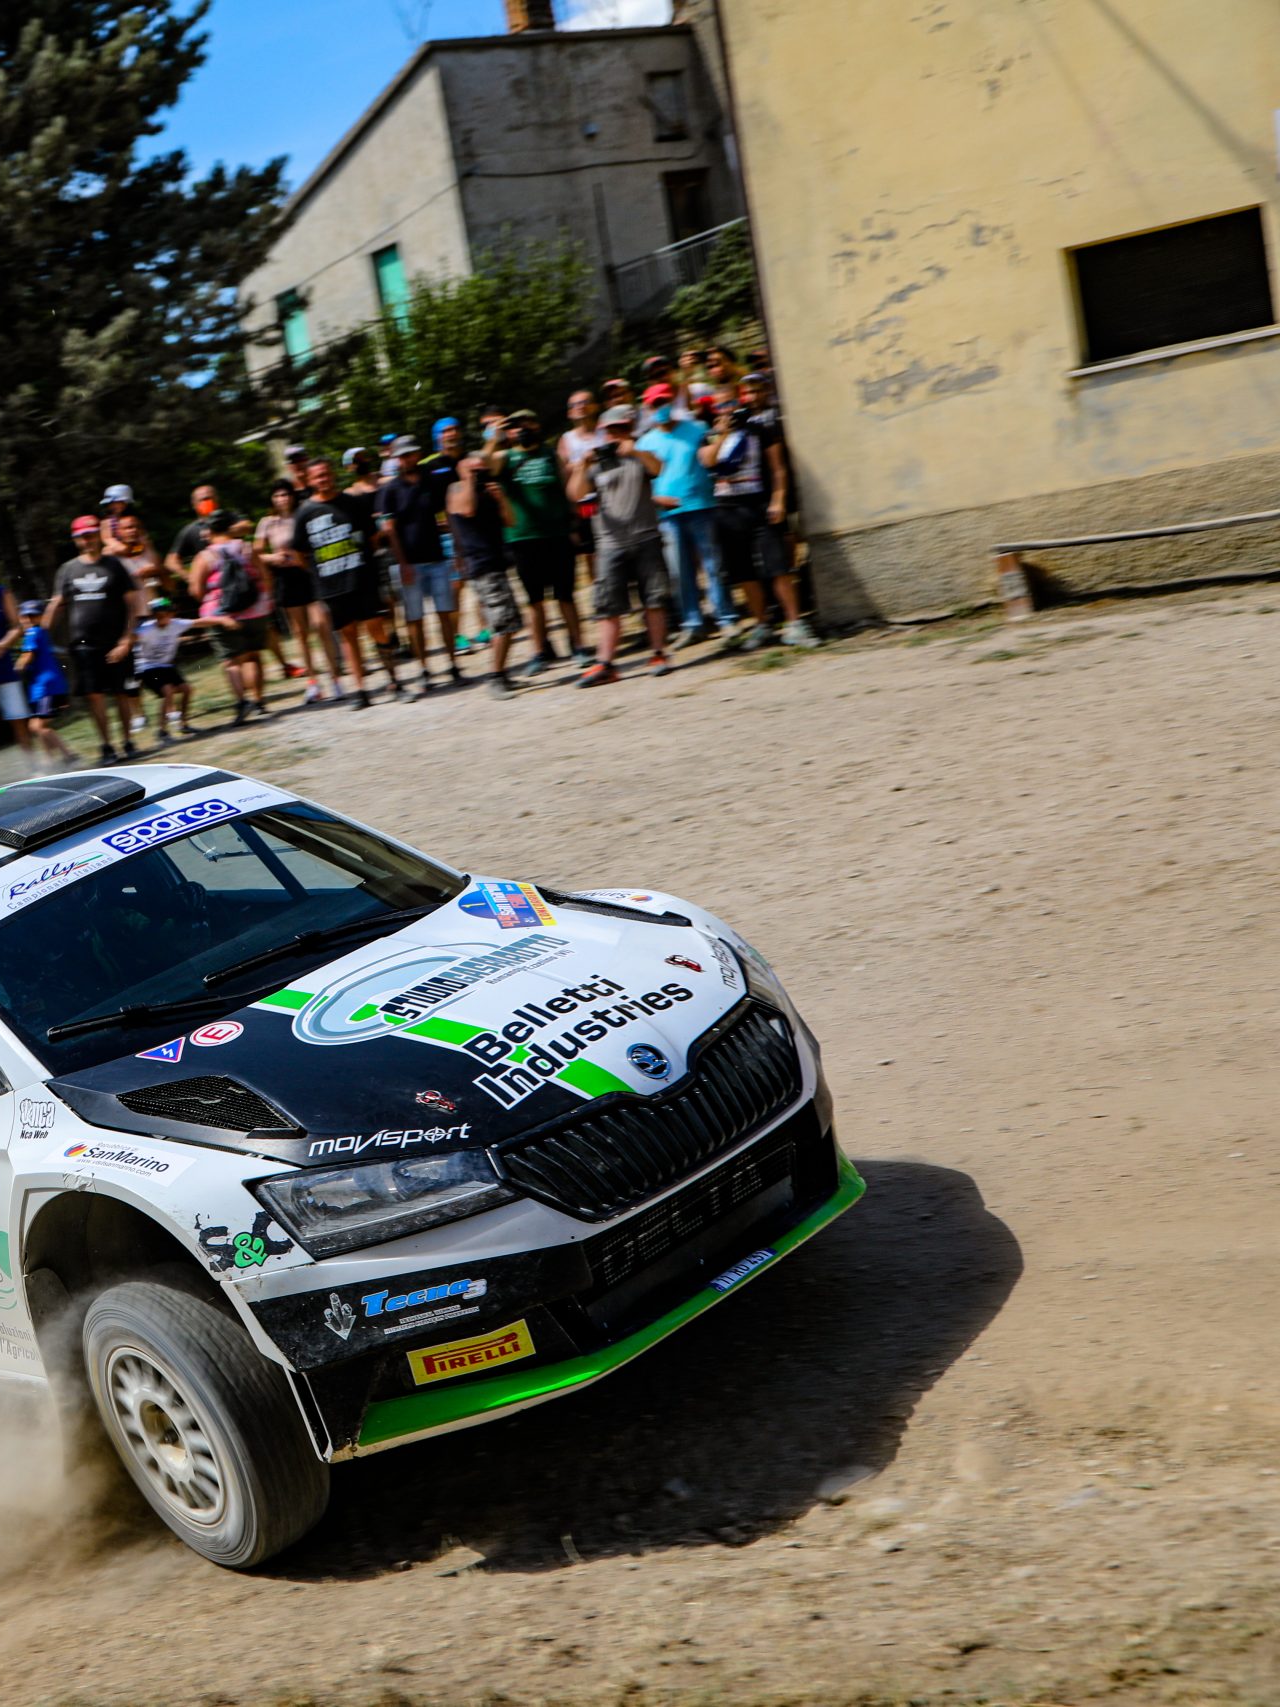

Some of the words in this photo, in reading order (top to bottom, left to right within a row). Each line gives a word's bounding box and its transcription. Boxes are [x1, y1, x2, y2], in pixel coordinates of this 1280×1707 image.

[111, 801, 228, 846] sparco
[7, 877, 69, 910] Campionato
[74, 856, 115, 881] Italiano
[9, 860, 77, 900] Rally
[200, 1027, 234, 1040] E
[463, 975, 625, 1065] Belletti
[477, 983, 693, 1106] Industries
[83, 1147, 169, 1173] SanMarino
[309, 1122, 472, 1157] movisport
[422, 1333, 520, 1375] PIRELLI
